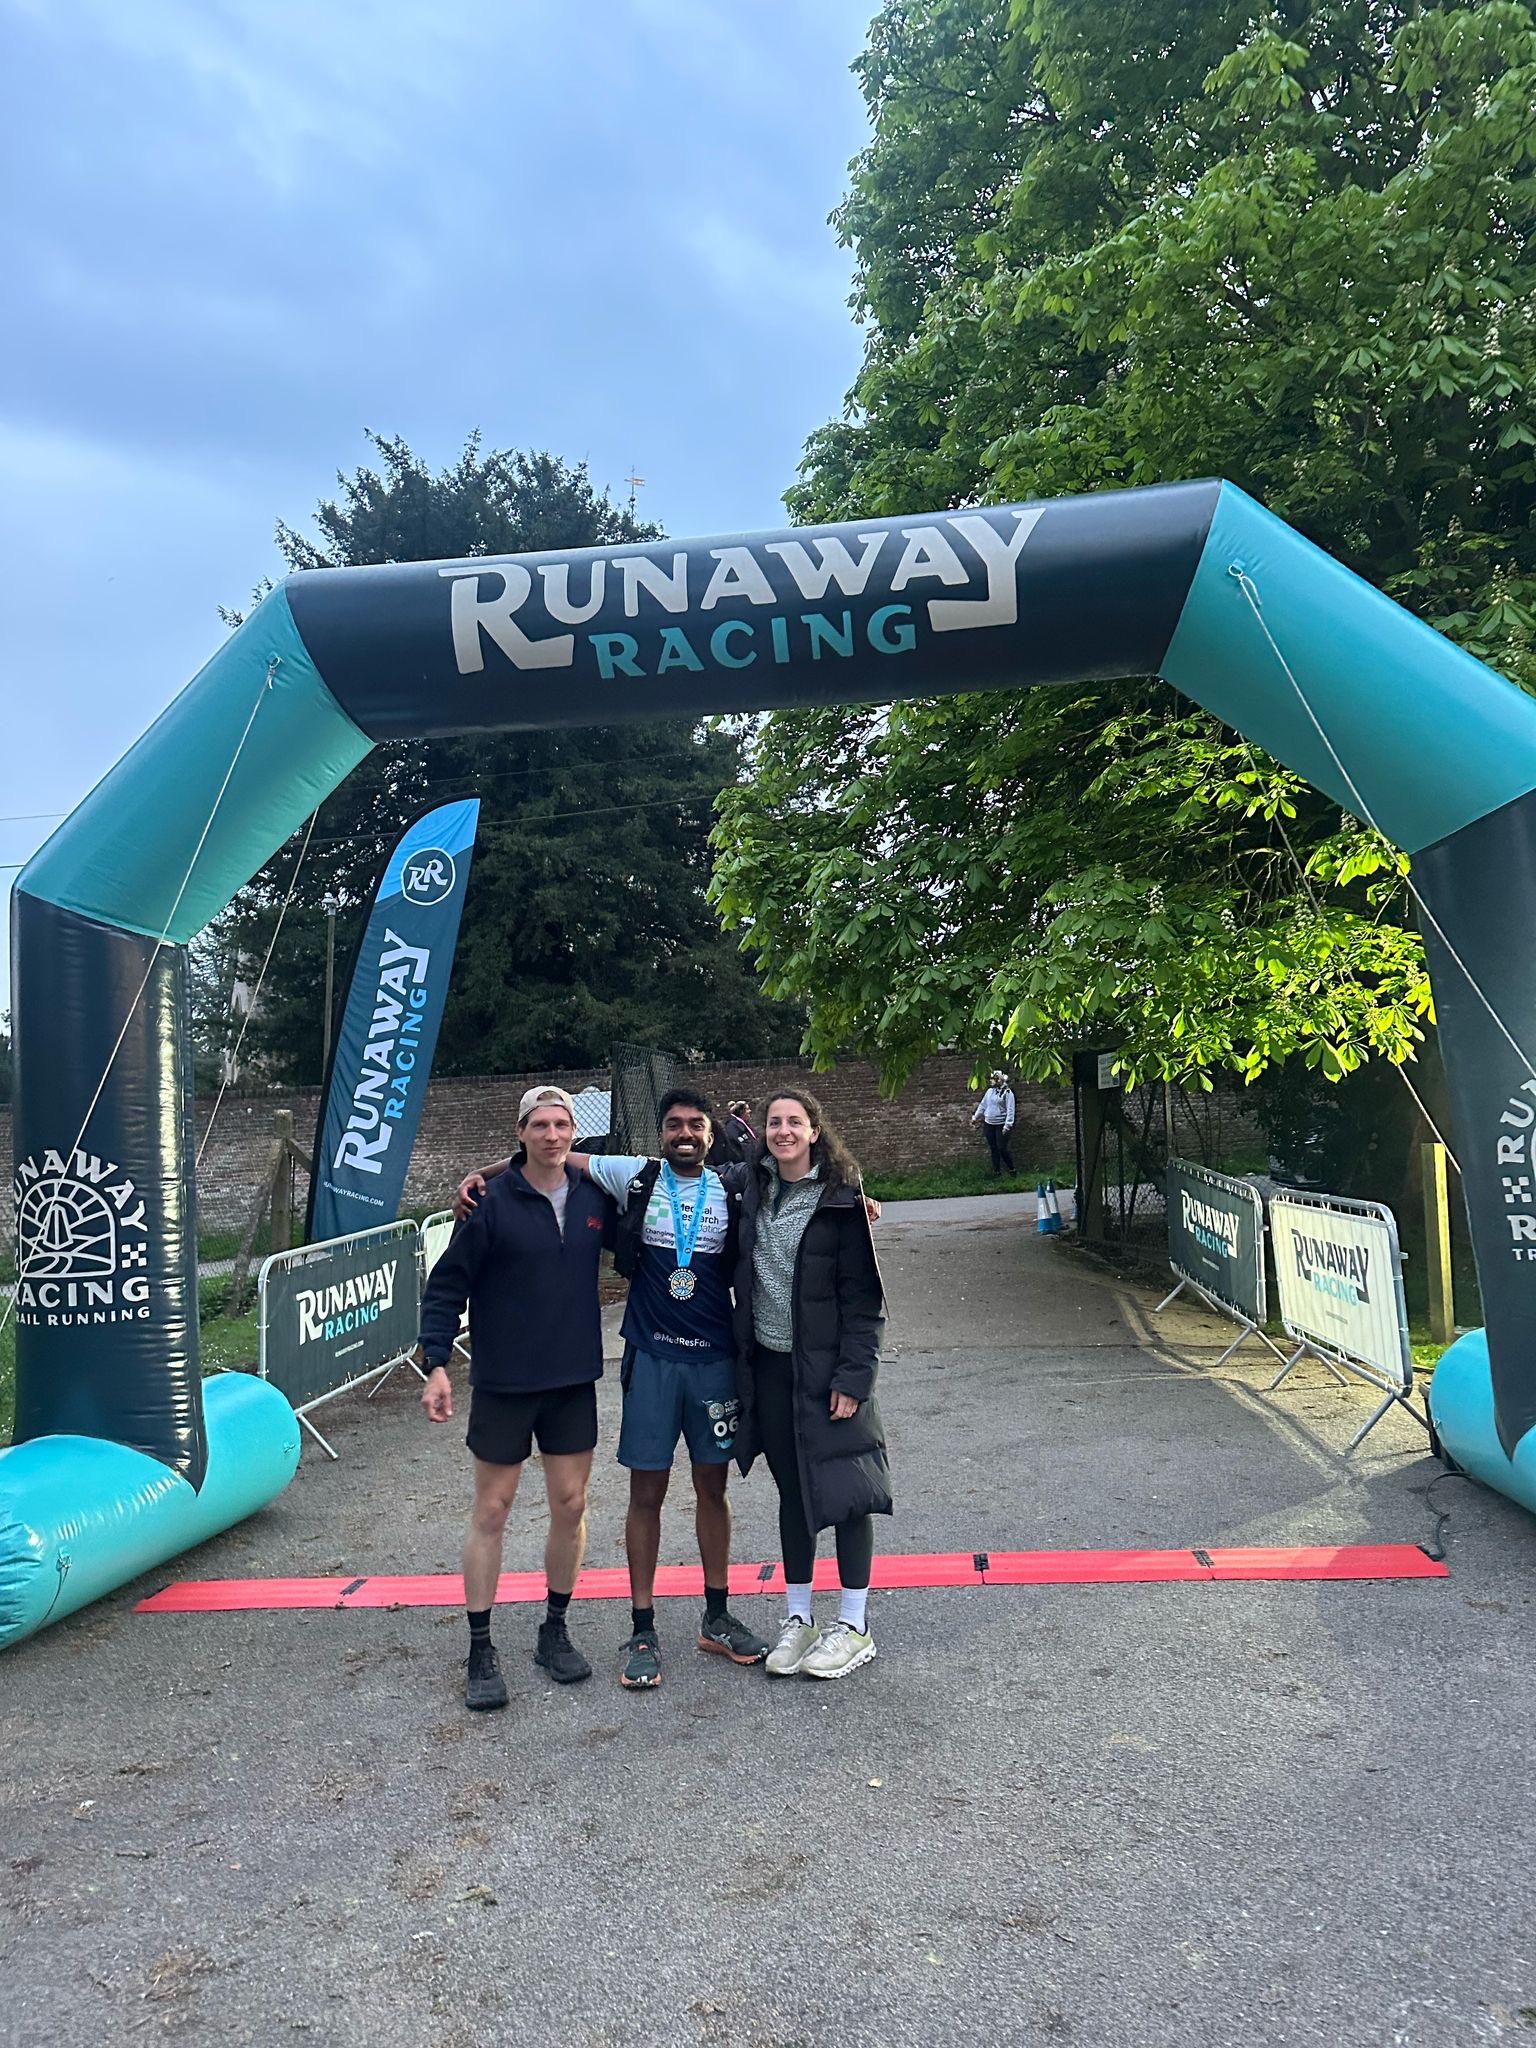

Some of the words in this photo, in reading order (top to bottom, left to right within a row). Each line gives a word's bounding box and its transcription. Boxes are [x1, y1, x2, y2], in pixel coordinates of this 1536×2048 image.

[438, 508, 1046, 674] RUNAWAY
[588, 604, 916, 679] RACING
[333, 927, 430, 1174] RUNAWAY
[384, 988, 427, 1119] RACING
[14, 1149, 148, 1232] UNAWAY
[682, 1214, 719, 1224] esarch
[1181, 1189, 1240, 1258] RUNAWAY
[1194, 1226, 1228, 1259] RACING
[1291, 1228, 1370, 1304] RUNAWAY
[47, 1306, 150, 1326] RUNNING
[296, 1260, 397, 1346] RUNAWAY
[325, 1301, 379, 1341] RACING
[1312, 1273, 1358, 1306] RACING
[653, 1331, 711, 1348] @MedResFdn
